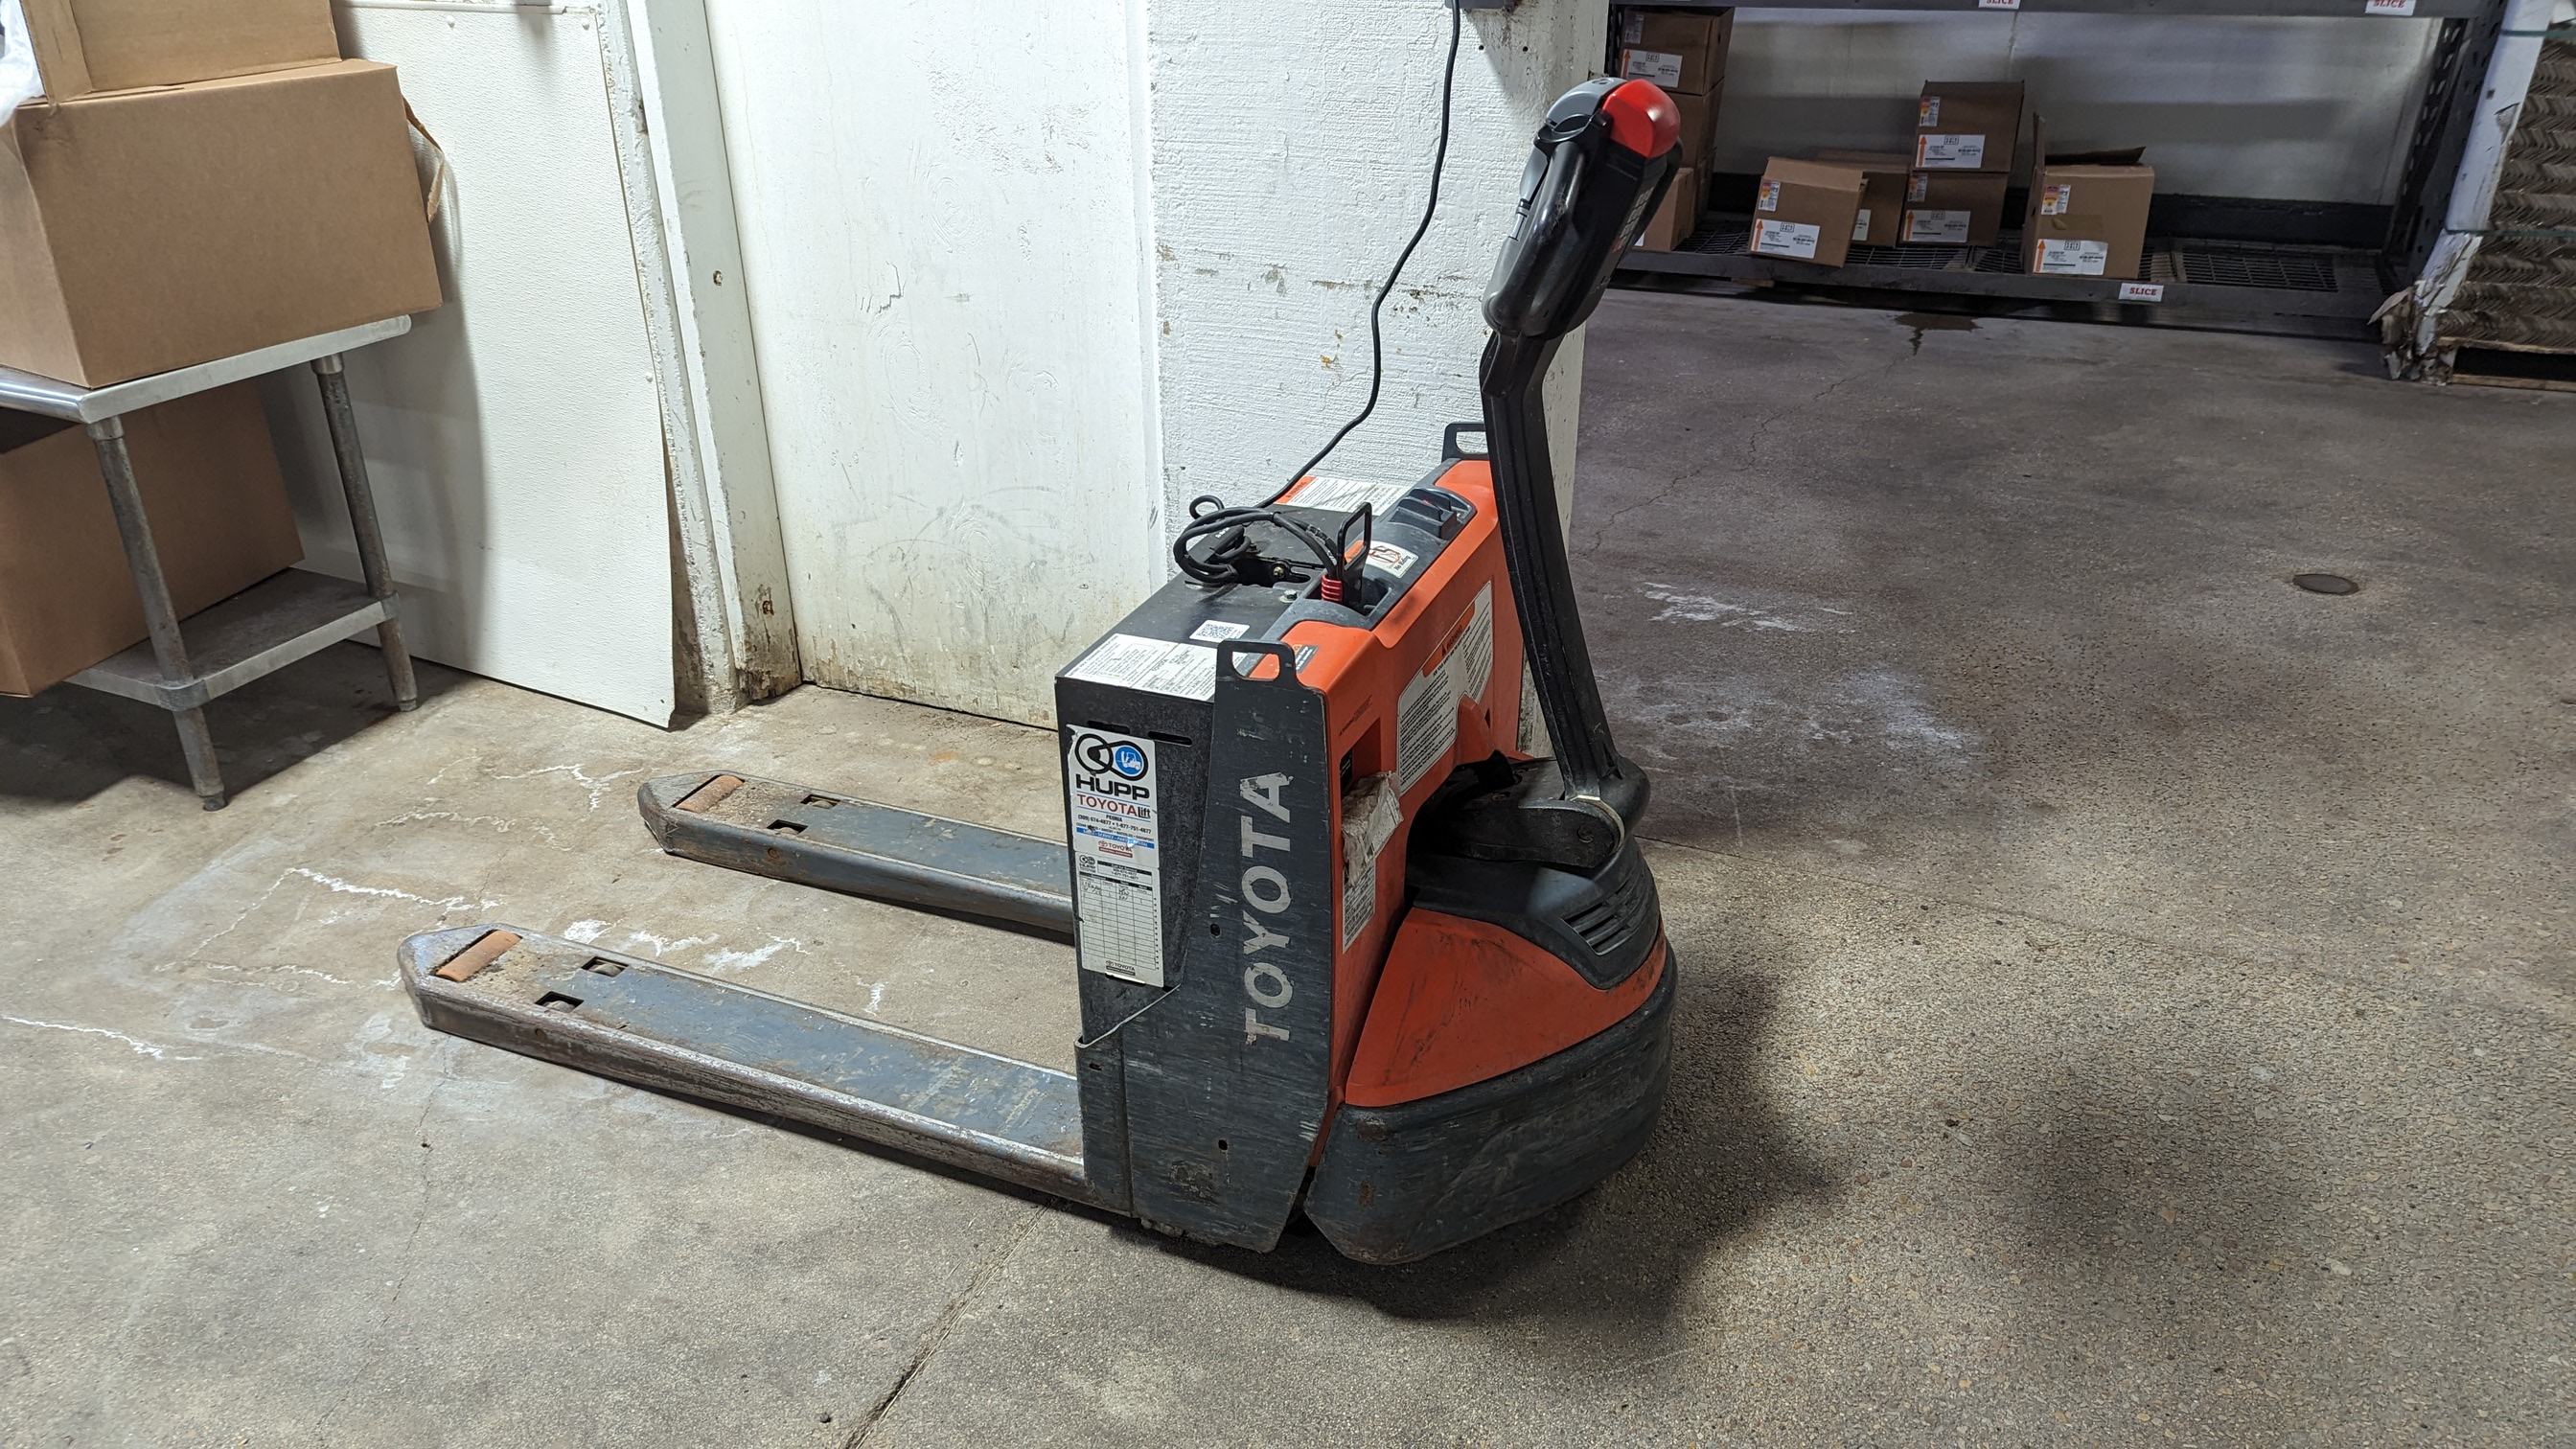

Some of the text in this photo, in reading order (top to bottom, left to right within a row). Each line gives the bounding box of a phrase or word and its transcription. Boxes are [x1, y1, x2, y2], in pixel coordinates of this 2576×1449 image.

[2128, 287, 2157, 296] SLICE
[1075, 773, 1150, 801] HUPP
[1106, 814, 1123, 823] PEORIA
[1109, 841, 1133, 853] TOYOTA
[1240, 771, 1294, 1046] TOYOTA
